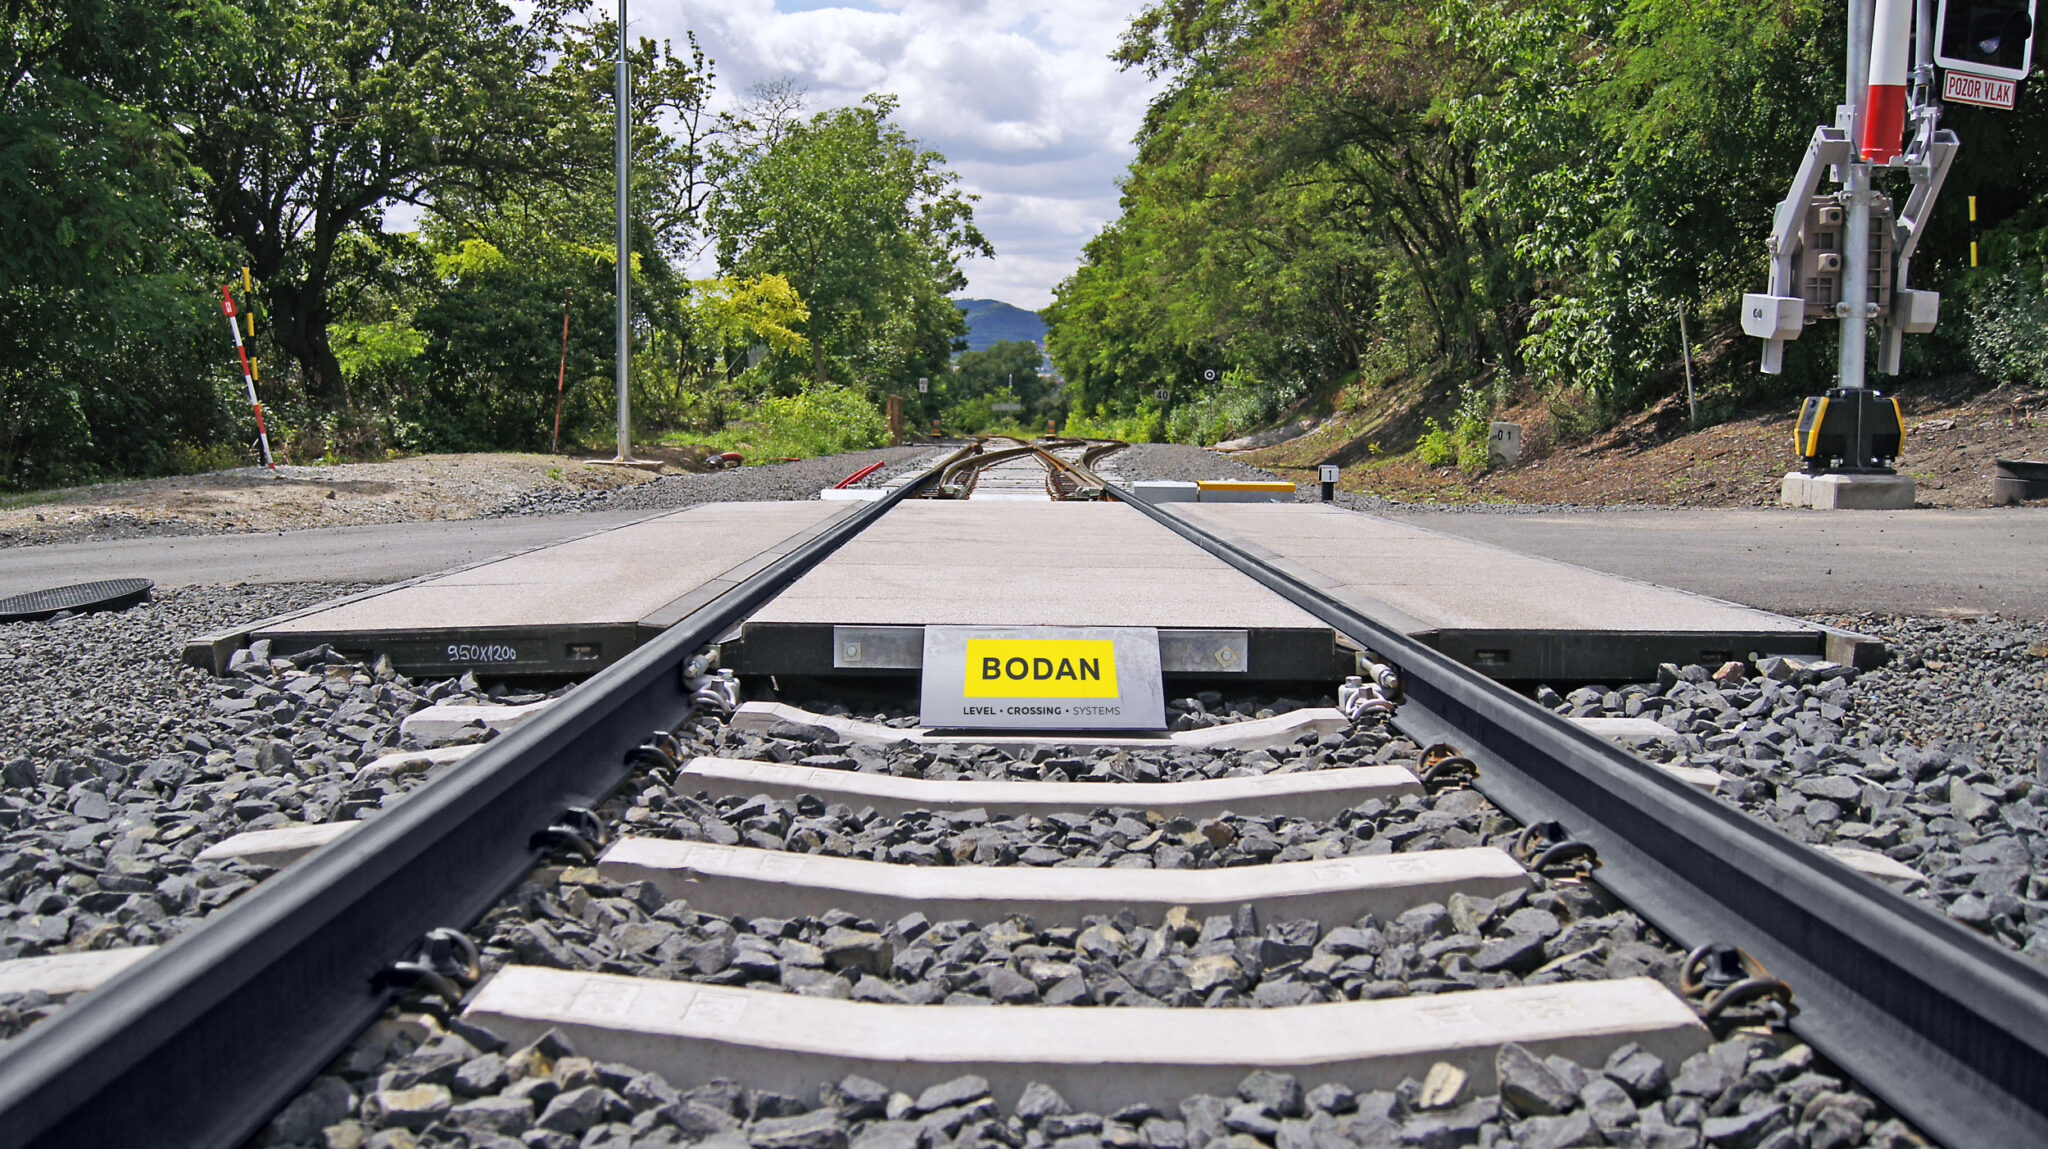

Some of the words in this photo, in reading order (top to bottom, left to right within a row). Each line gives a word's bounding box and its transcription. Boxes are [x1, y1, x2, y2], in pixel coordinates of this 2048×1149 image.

[1948, 77, 1980, 98] POZOR
[1984, 82, 2011, 103] VLAK
[982, 657, 1100, 681] BODAN
[963, 706, 996, 715] LEVEL
[1007, 706, 1062, 715] CROSSING
[1073, 706, 1121, 715] SYSTEMS
